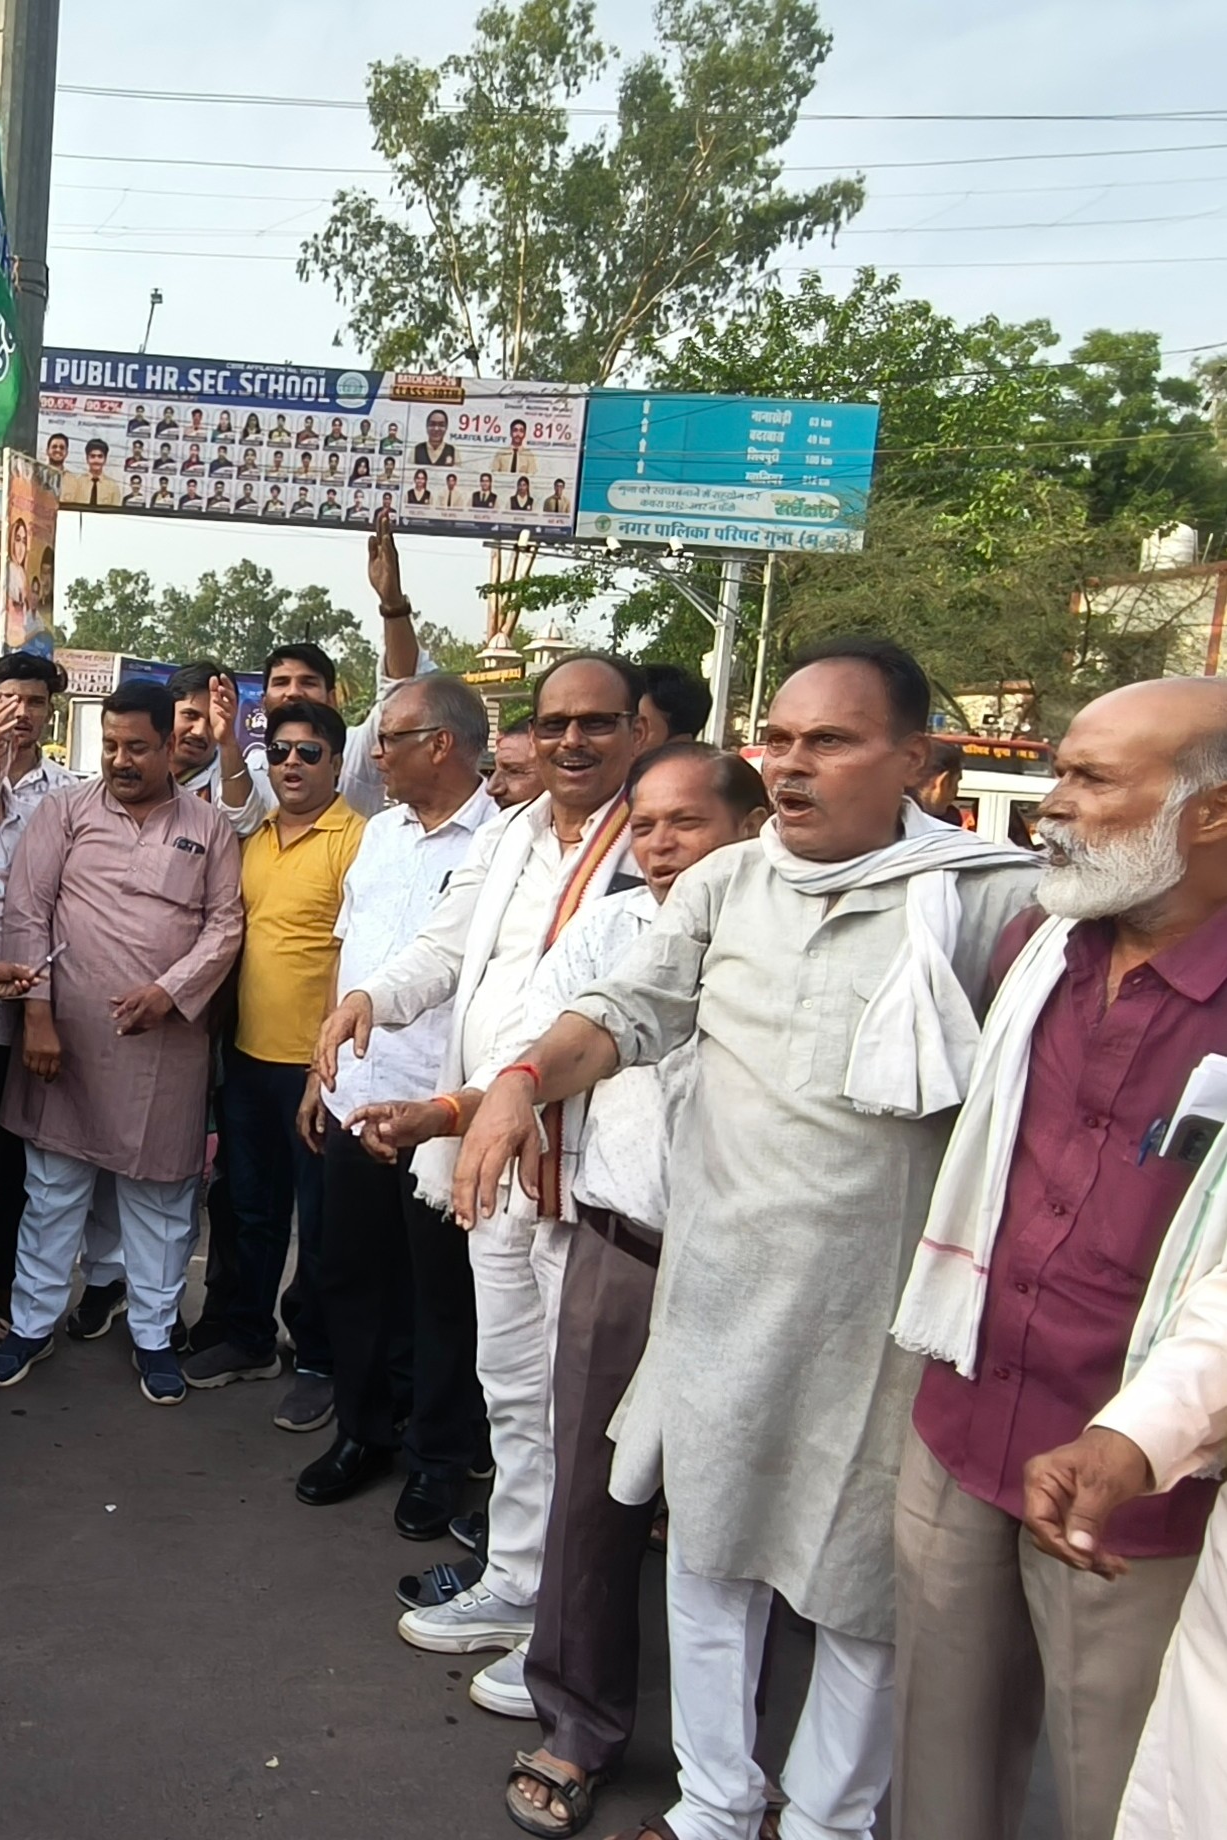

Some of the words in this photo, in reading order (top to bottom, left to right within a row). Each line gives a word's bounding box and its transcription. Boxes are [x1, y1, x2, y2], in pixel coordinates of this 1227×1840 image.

[54, 358, 139, 389] PUBLIC
[397, 373, 422, 384] BATCH
[393, 386, 425, 398] CLASS
[458, 413, 502, 435] 91%
[820, 418, 833, 428] km
[532, 422, 572, 442] 81%
[819, 436, 831, 446] km
[746, 446, 781, 467] शिवपुरी
[820, 456, 833, 466] km
[618, 521, 650, 537] नगर
[654, 519, 710, 541] पालिका
[714, 525, 760, 544] परिषद
[763, 530, 793, 549] गुना
